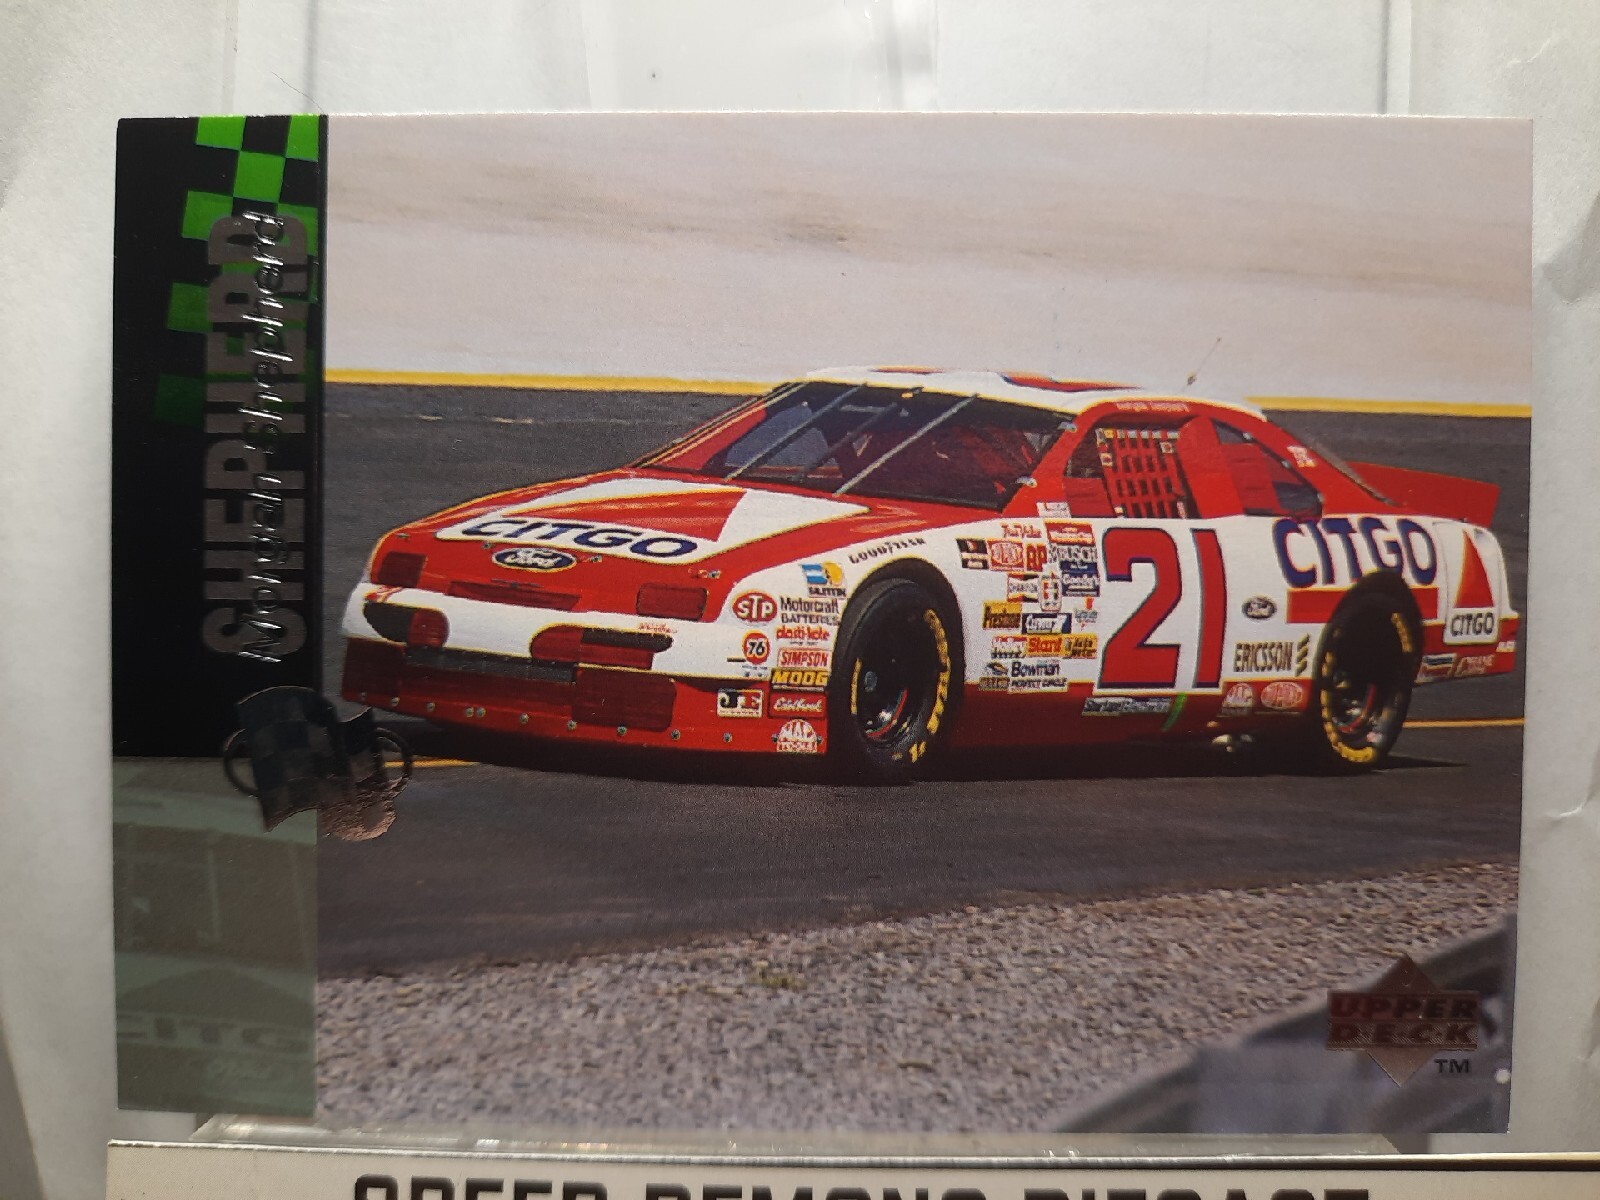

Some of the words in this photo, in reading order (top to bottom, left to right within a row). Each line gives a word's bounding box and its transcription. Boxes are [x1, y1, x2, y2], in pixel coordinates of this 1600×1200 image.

[202, 213, 308, 656] SHEPHERD
[461, 518, 698, 558] CITGO
[1272, 516, 1437, 588] CITGO
[736, 594, 774, 618] STP
[780, 597, 840, 614] Motorcraft
[1098, 527, 1227, 688] 21
[781, 614, 840, 626] BATTERIES
[1451, 612, 1495, 637] CITGO
[747, 640, 766, 659] 76
[780, 651, 828, 667] SIMPSON
[1233, 642, 1294, 673] ERICSSON
[772, 670, 829, 687] MOOG
[1330, 997, 1477, 1019] UPPER
[1331, 1022, 1474, 1044] DECK
[1434, 1057, 1470, 1074] TM
